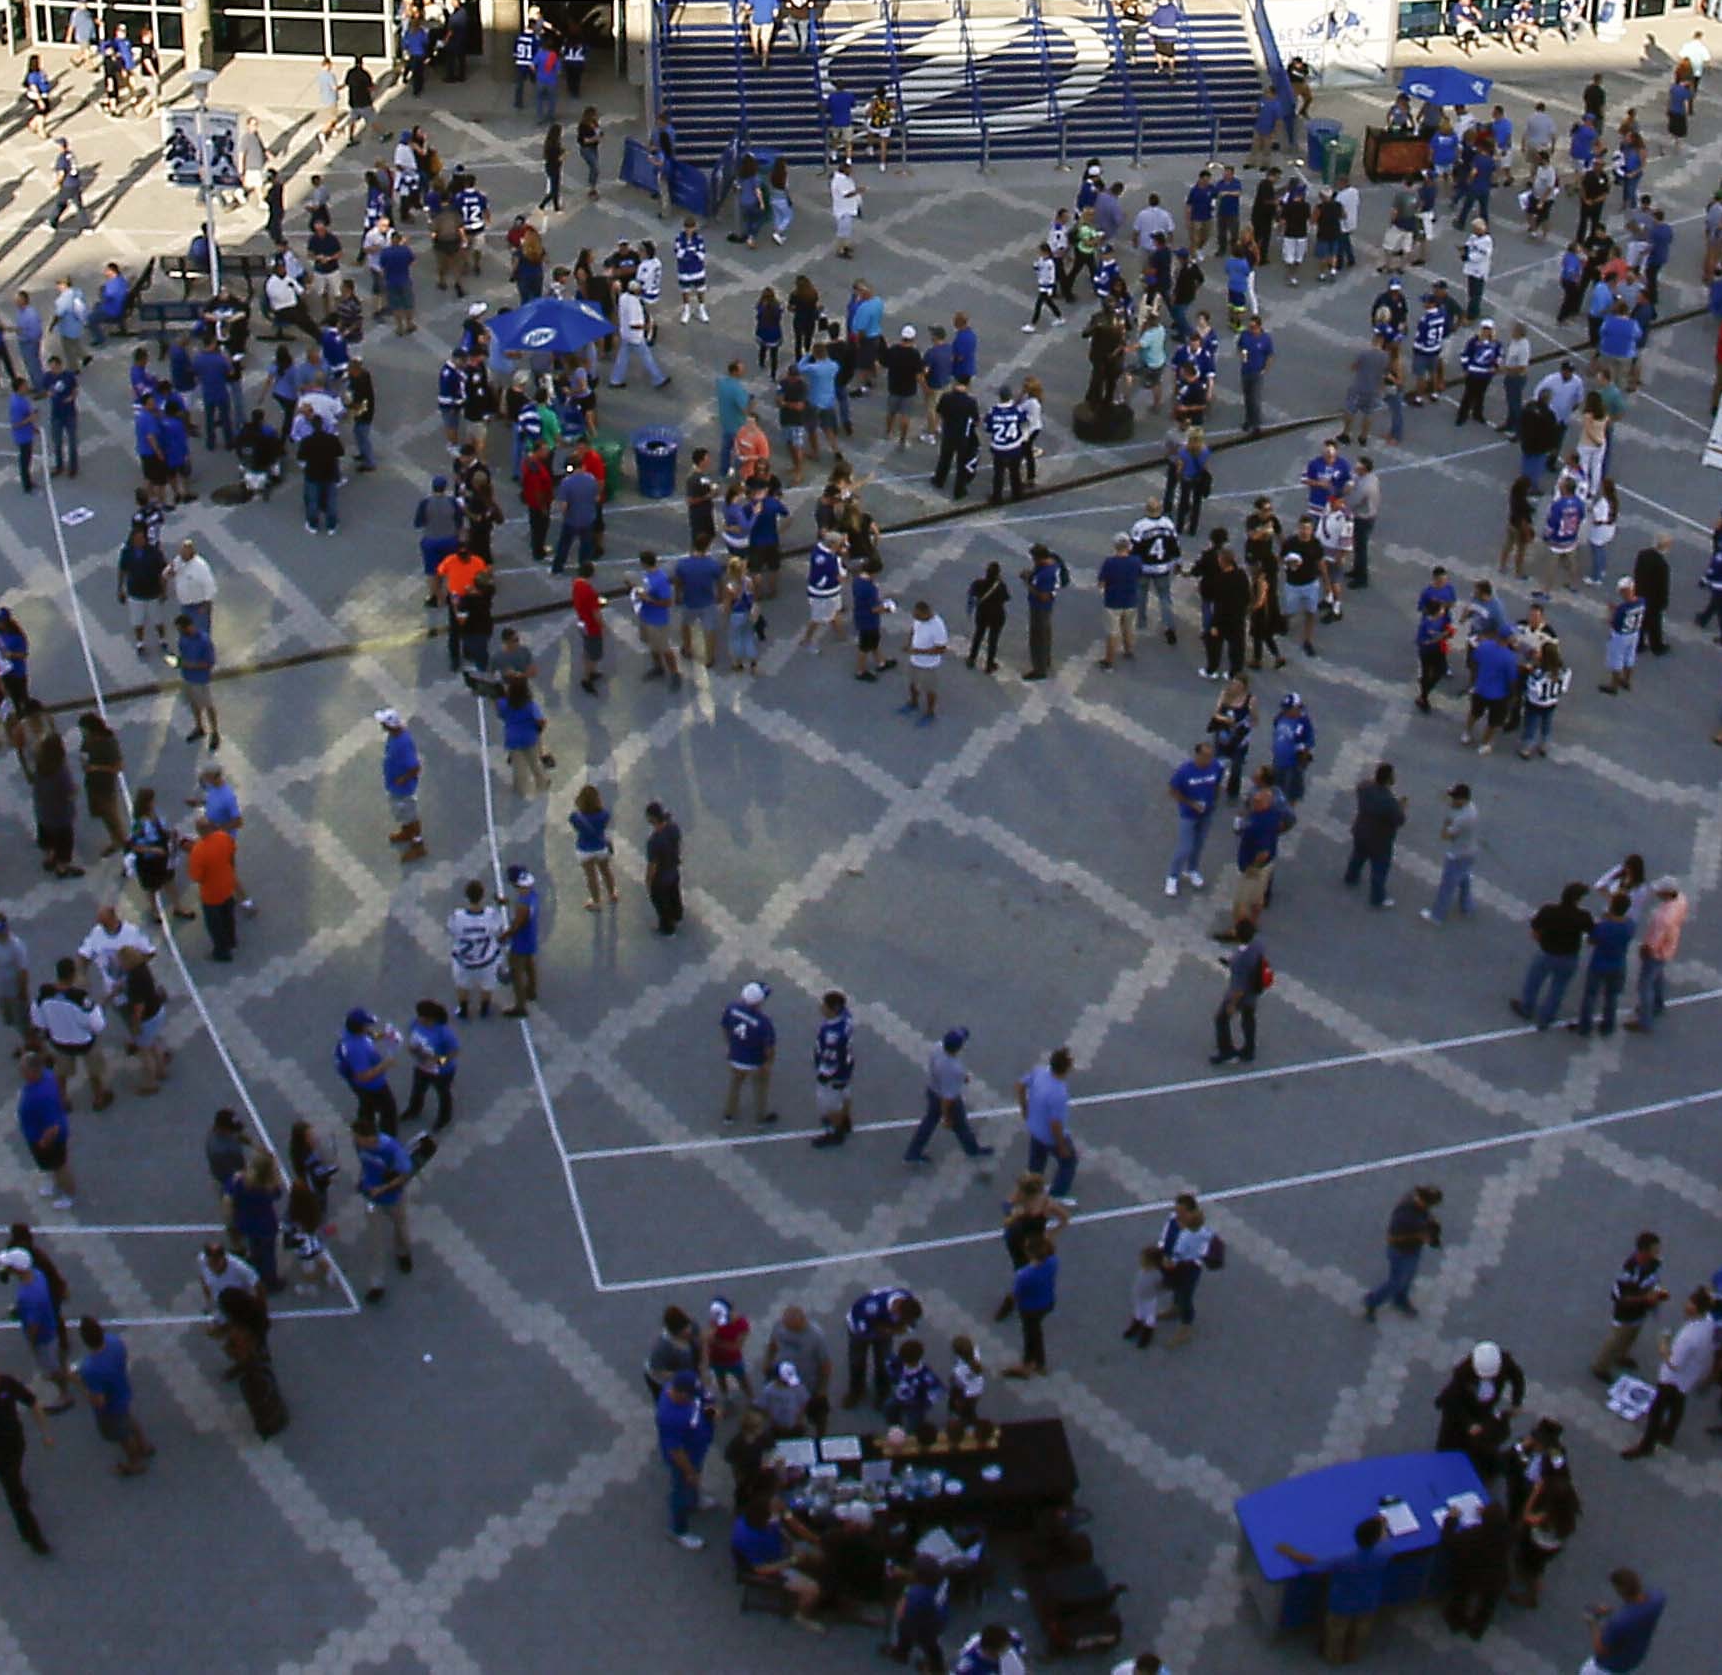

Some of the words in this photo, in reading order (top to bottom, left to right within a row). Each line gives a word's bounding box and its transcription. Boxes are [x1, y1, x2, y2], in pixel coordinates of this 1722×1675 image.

[517, 44, 533, 59] 91
[461, 205, 481, 223] 12
[992, 423, 1019, 443] 24
[1150, 538, 1165, 560] 4
[459, 938, 490, 958] 27
[734, 1023, 746, 1040] 4
